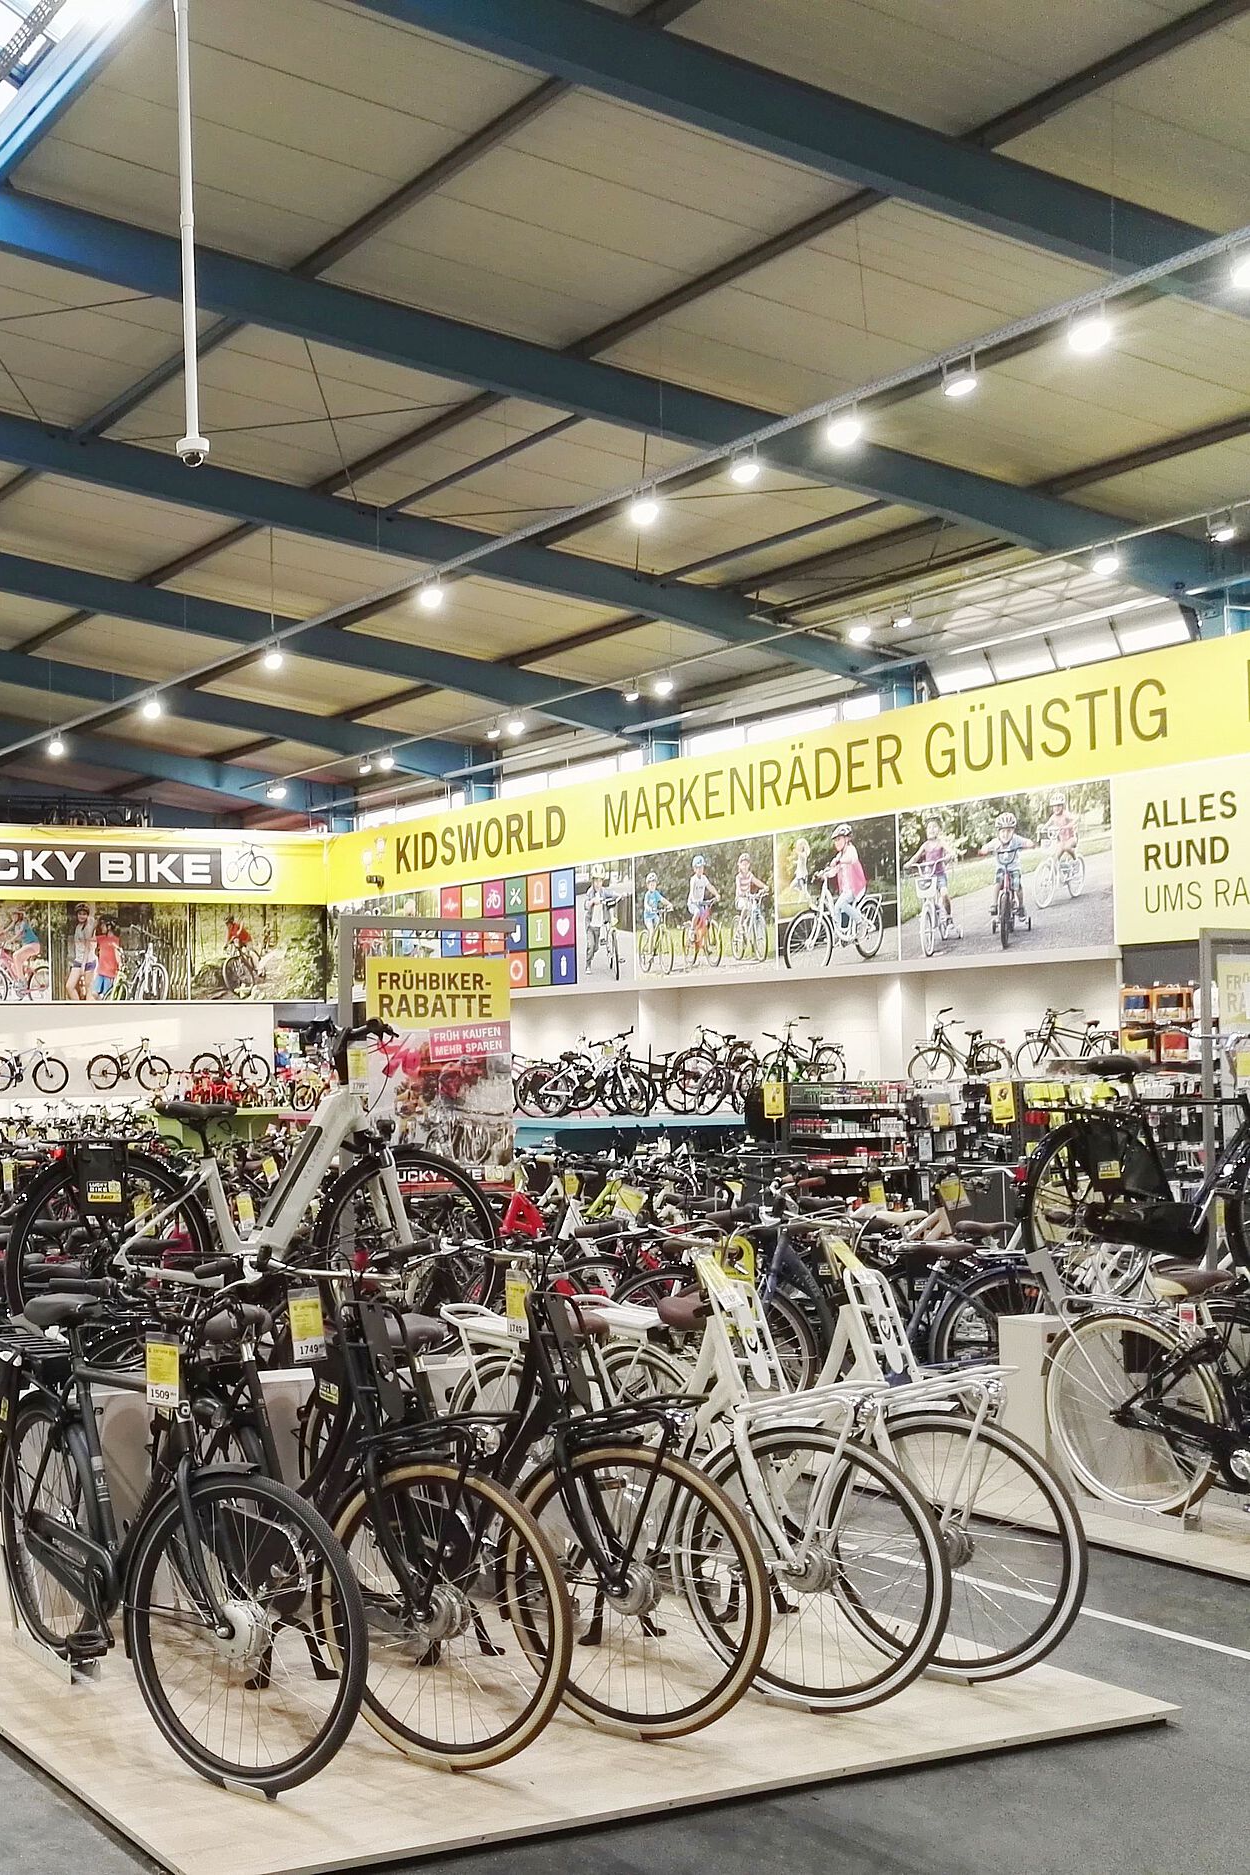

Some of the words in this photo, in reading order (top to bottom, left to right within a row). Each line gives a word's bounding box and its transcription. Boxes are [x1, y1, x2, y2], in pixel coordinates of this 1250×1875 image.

[395, 805, 566, 875] KIDSWORLD
[604, 733, 903, 838] MARKENRÄDER
[925, 678, 1168, 779] GÜNSTIG
[1141, 790, 1238, 830] ALLES
[1143, 836, 1230, 872] RUND
[99, 852, 212, 885] BIKE
[1145, 880, 1202, 914] UMS
[377, 969, 492, 991] FRÜHBIKER-
[378, 993, 493, 1018] RABATTE
[434, 1030, 460, 1043] FRÜH
[462, 1027, 501, 1040] KAUFEN
[435, 1043, 463, 1056] MEHR
[465, 1040, 503, 1053] SPAREN
[396, 1169, 439, 1182] UCKY
[299, 1343, 319, 1355] 1749
[150, 1388, 170, 1400] 1509
